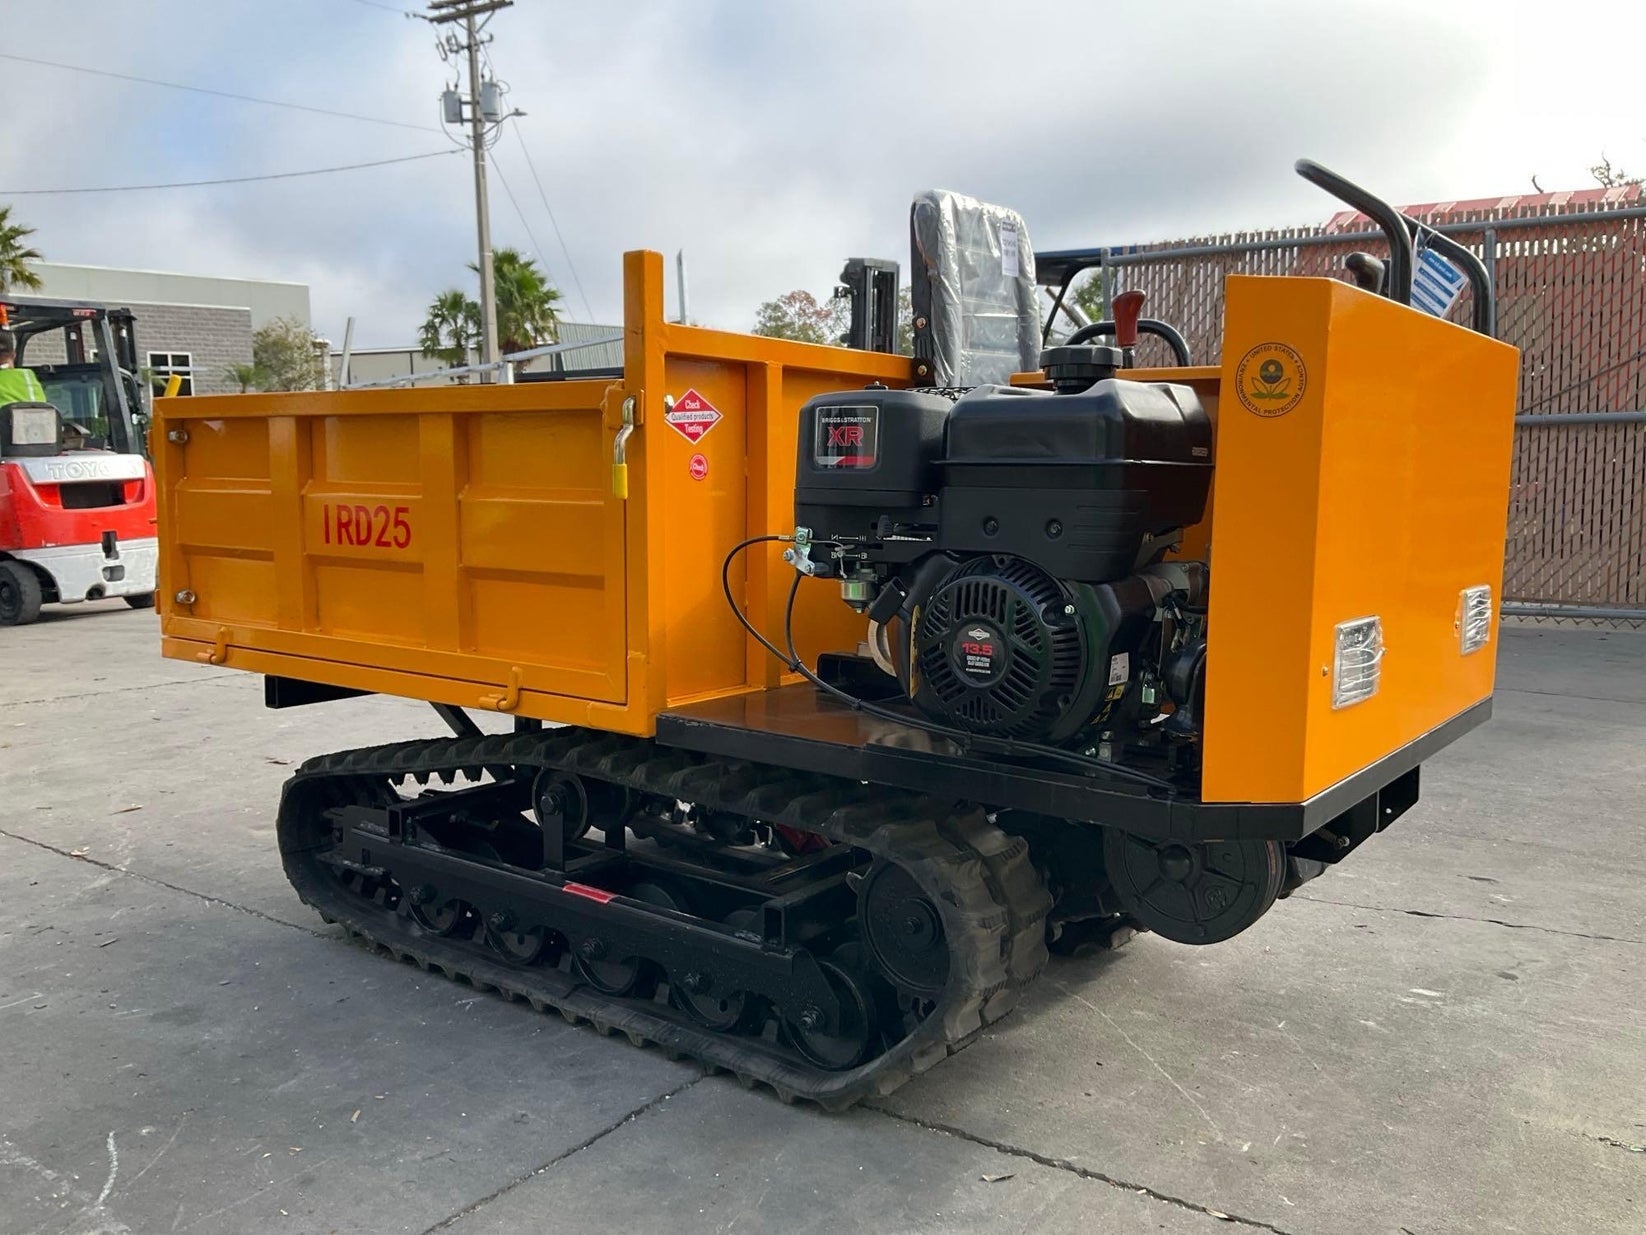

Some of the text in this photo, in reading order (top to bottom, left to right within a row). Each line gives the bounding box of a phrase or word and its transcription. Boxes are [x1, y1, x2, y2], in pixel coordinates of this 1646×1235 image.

[684, 423, 704, 435] Testing
[826, 426, 864, 447] XR
[323, 504, 412, 549] IRD25
[962, 642, 993, 656] 13.5
